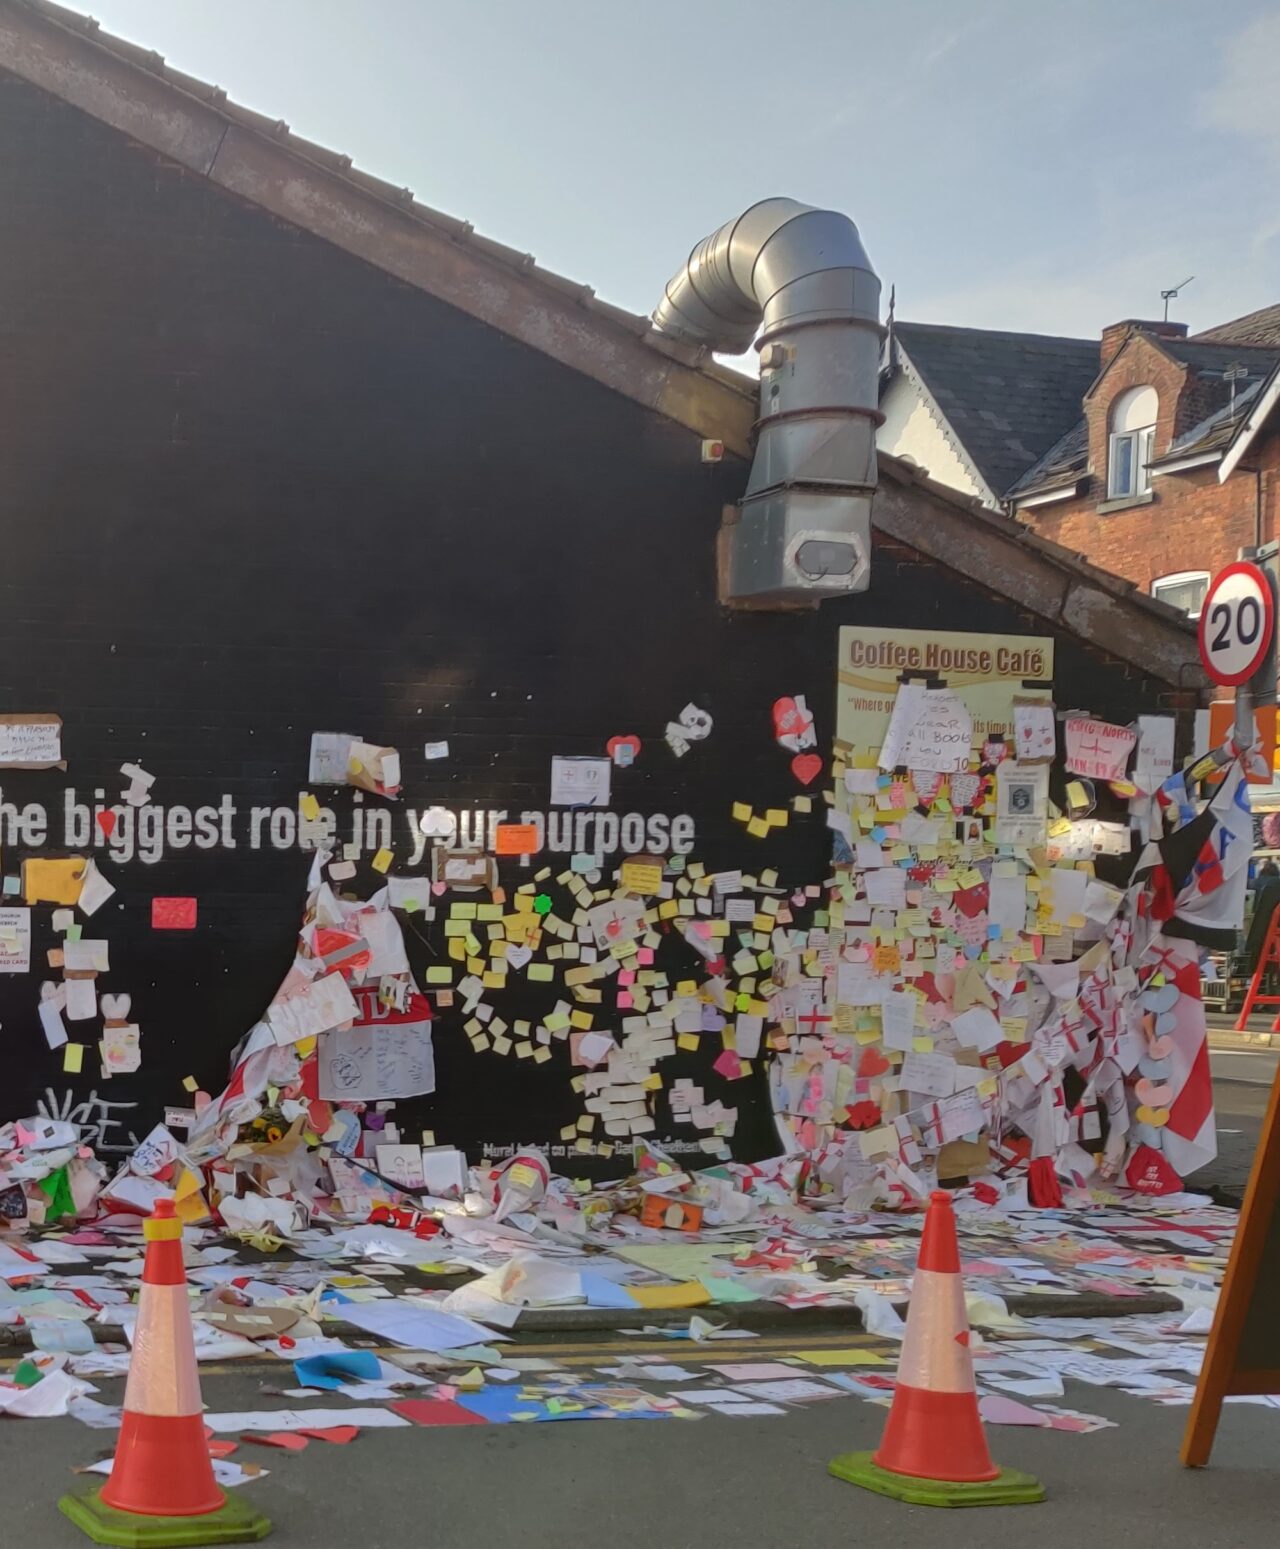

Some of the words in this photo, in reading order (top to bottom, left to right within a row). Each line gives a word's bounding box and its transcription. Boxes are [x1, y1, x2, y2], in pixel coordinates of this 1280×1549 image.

[1211, 596, 1260, 652] 20
[850, 639, 920, 668] Coffee
[926, 643, 991, 672] House
[996, 647, 1044, 676] Café
[64, 788, 236, 864] biggest
[345, 789, 392, 851] in
[520, 810, 695, 867] purpose
